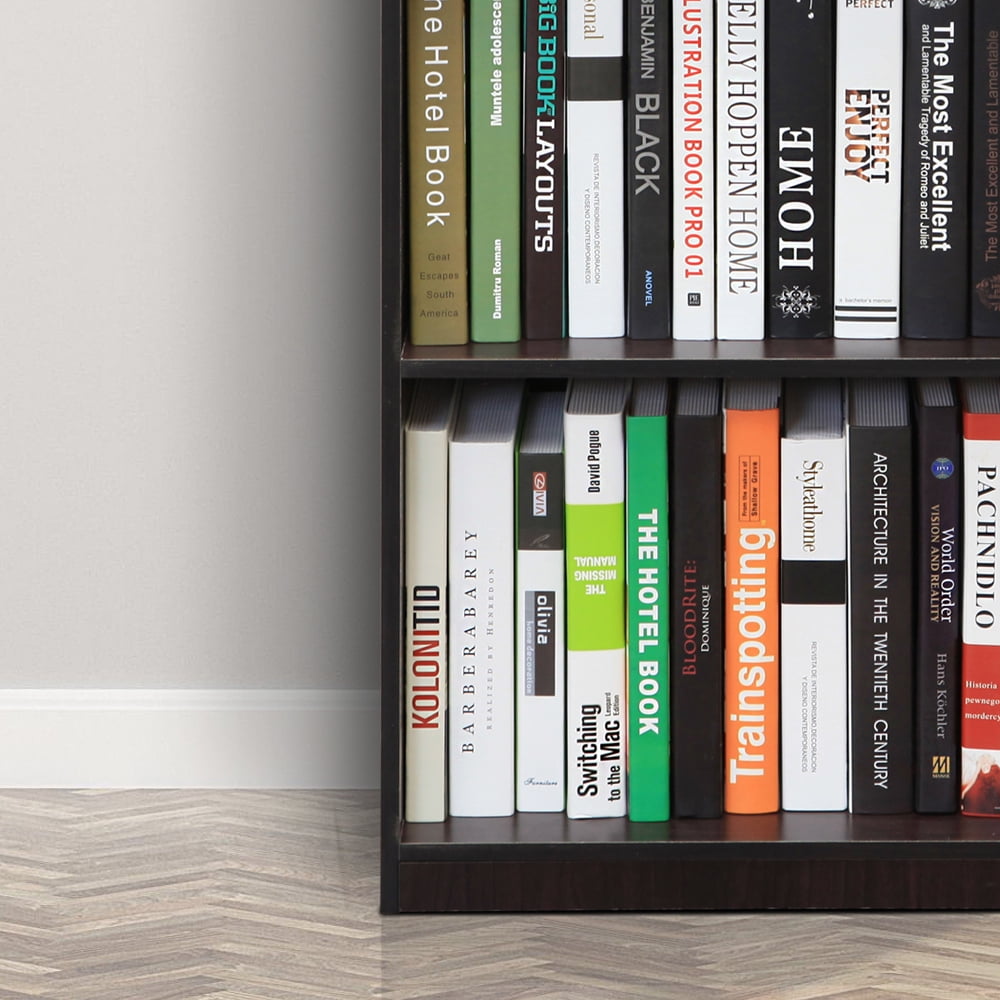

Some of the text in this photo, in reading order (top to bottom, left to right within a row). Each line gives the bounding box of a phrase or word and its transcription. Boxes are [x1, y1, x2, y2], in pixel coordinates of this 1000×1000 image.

[845, 0, 895, 9] PERFECT
[424, 46, 450, 132] Hotel
[490, 69, 502, 126] Muntele
[534, 36, 557, 252] BOOK LAYOUTS
[635, 93, 660, 196] BLACK
[728, 80, 758, 198] HOPPEN
[845, 89, 871, 183] ENJOY
[871, 90, 890, 184] PERFECT
[919, 24, 932, 249] and Lamentable Tragedy of Romeo and Juliet
[931, 22, 954, 252] The Most Excellent
[985, 30, 999, 262] The Most Excellent and Lamentable
[425, 145, 450, 227] Book
[684, 140, 703, 278] BOOK PRO 01
[778, 127, 814, 271] HOME
[426, 290, 454, 299] South
[492, 239, 502, 319] Dumitru Roman
[728, 207, 758, 294] HOME
[419, 309, 459, 318] America
[587, 430, 602, 493] David Pogue
[796, 460, 824, 552] Styleathome
[574, 556, 617, 566] MANUAL
[574, 570, 617, 581] MISSING
[585, 584, 606, 594] THE
[930, 504, 940, 622] VISION AND REALITY
[941, 528, 955, 623] World Order
[975, 465, 997, 629] PACHNIDLO
[412, 585, 440, 729] KOLONITID
[462, 530, 478, 752] BARBERABAREY
[487, 645, 494, 659] BY
[526, 620, 534, 694] home decoration
[536, 595, 553, 645] olivia
[638, 508, 659, 735] THE HOTEL BOOK
[700, 584, 712, 652] DOMINIQUE
[730, 527, 775, 784] Trainspotting
[873, 452, 888, 790] ARCHITECTURE IN THE TWENTIETH CENTURY
[937, 653, 948, 739] Hans Köchler
[965, 680, 998, 690] Historia
[965, 698, 1000, 706] pewnego
[577, 704, 601, 796] Switching
[600, 720, 621, 801] to the Mac
